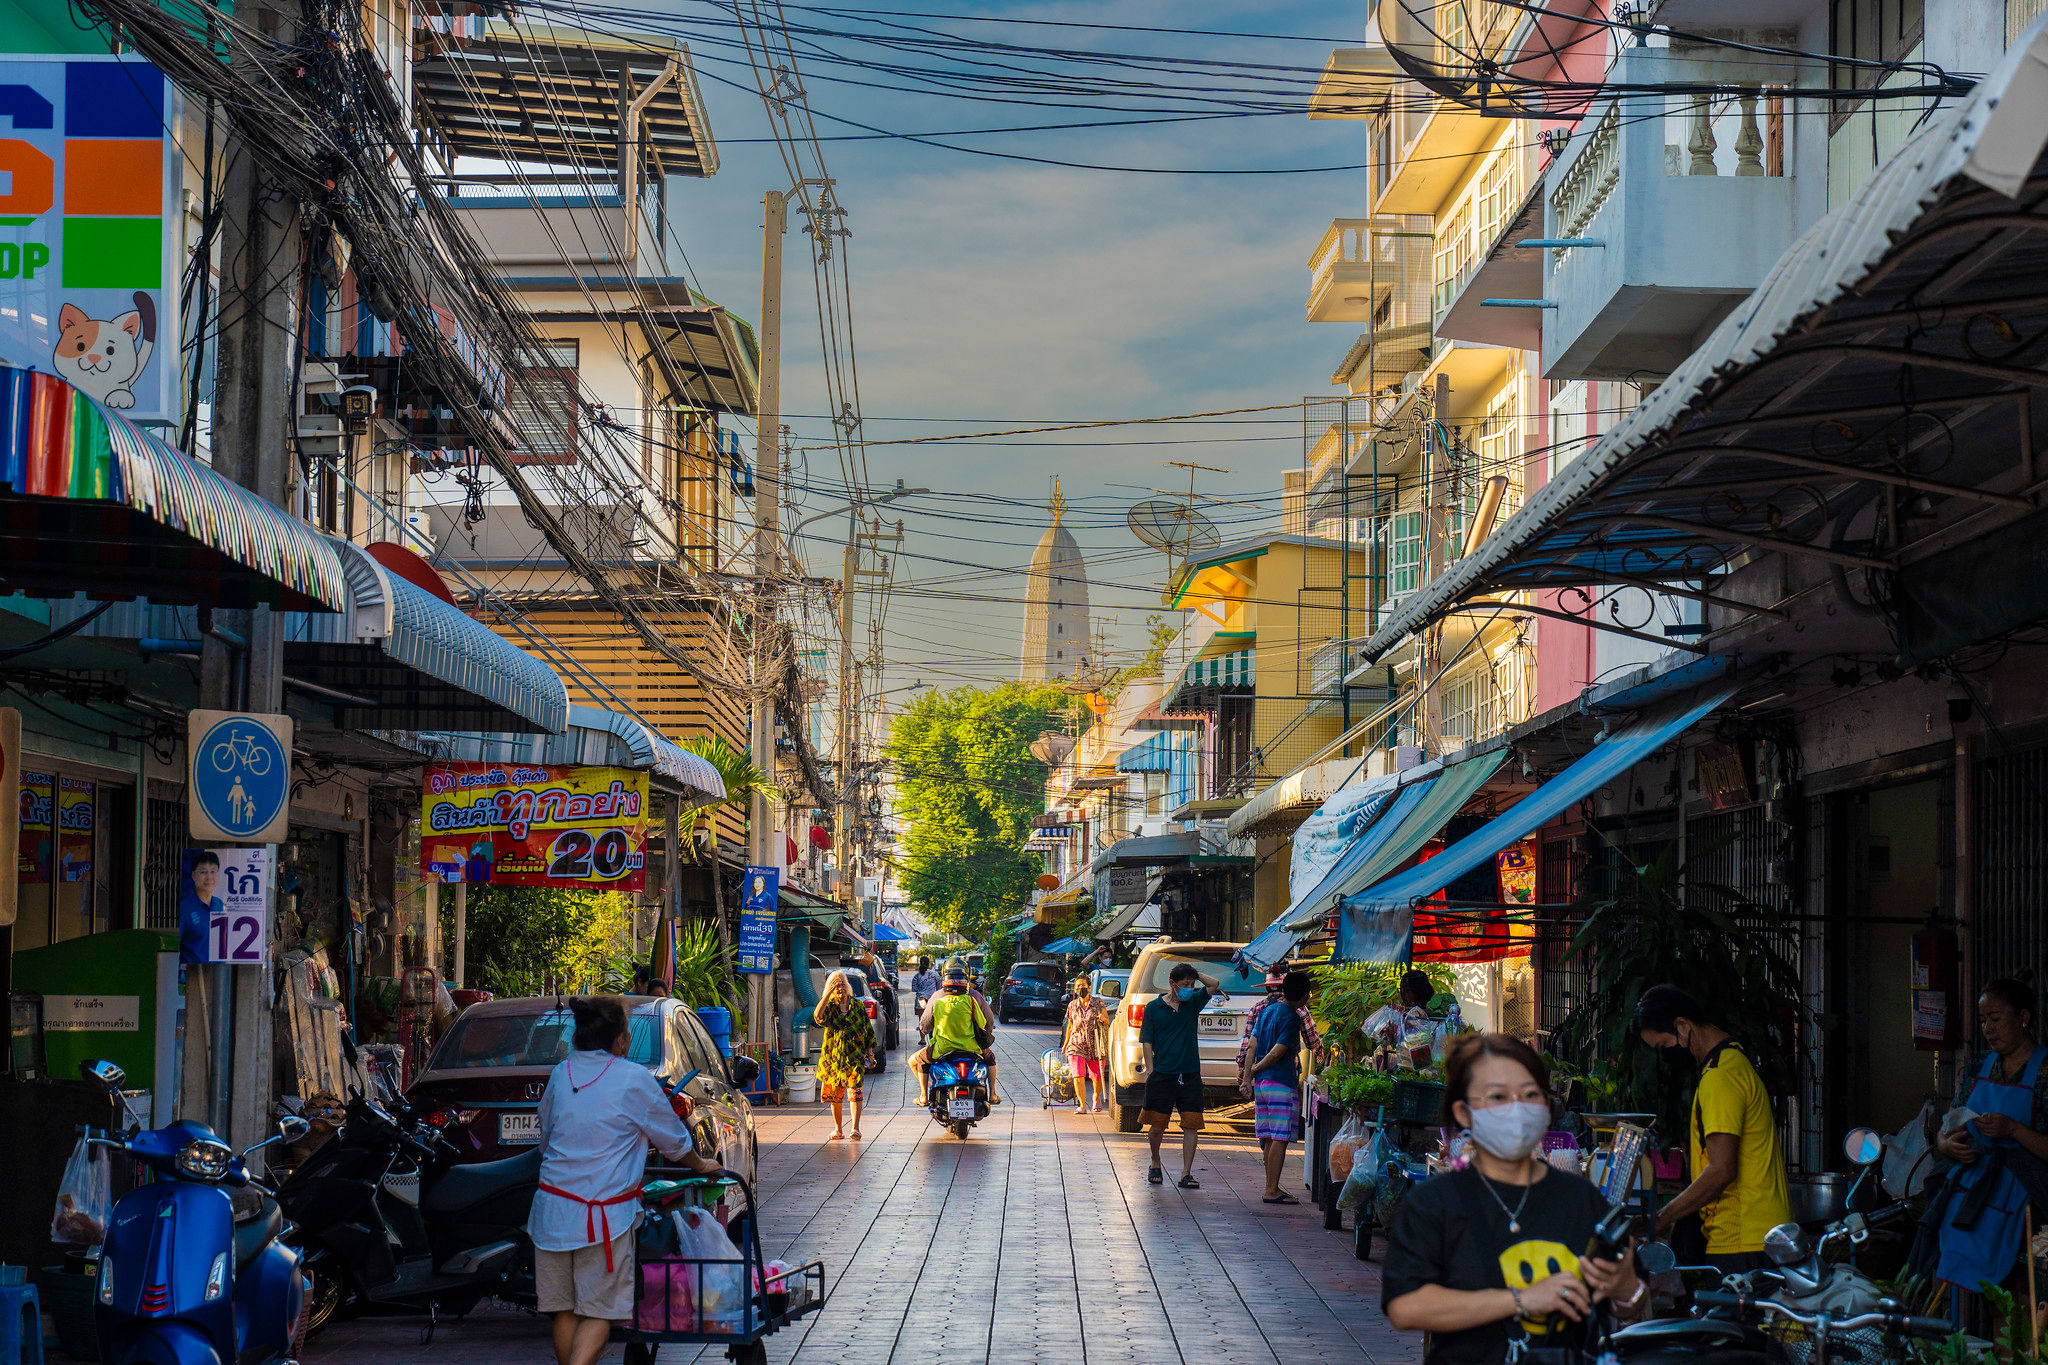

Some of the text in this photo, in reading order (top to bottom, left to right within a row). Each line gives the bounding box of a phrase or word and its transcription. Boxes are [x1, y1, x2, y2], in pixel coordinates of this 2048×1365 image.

[547, 828, 629, 879] 20
[224, 864, 261, 895] โก้
[210, 916, 260, 960] 12
[1217, 1018, 1233, 1027] 403
[504, 1116, 531, 1129] 3กผ
